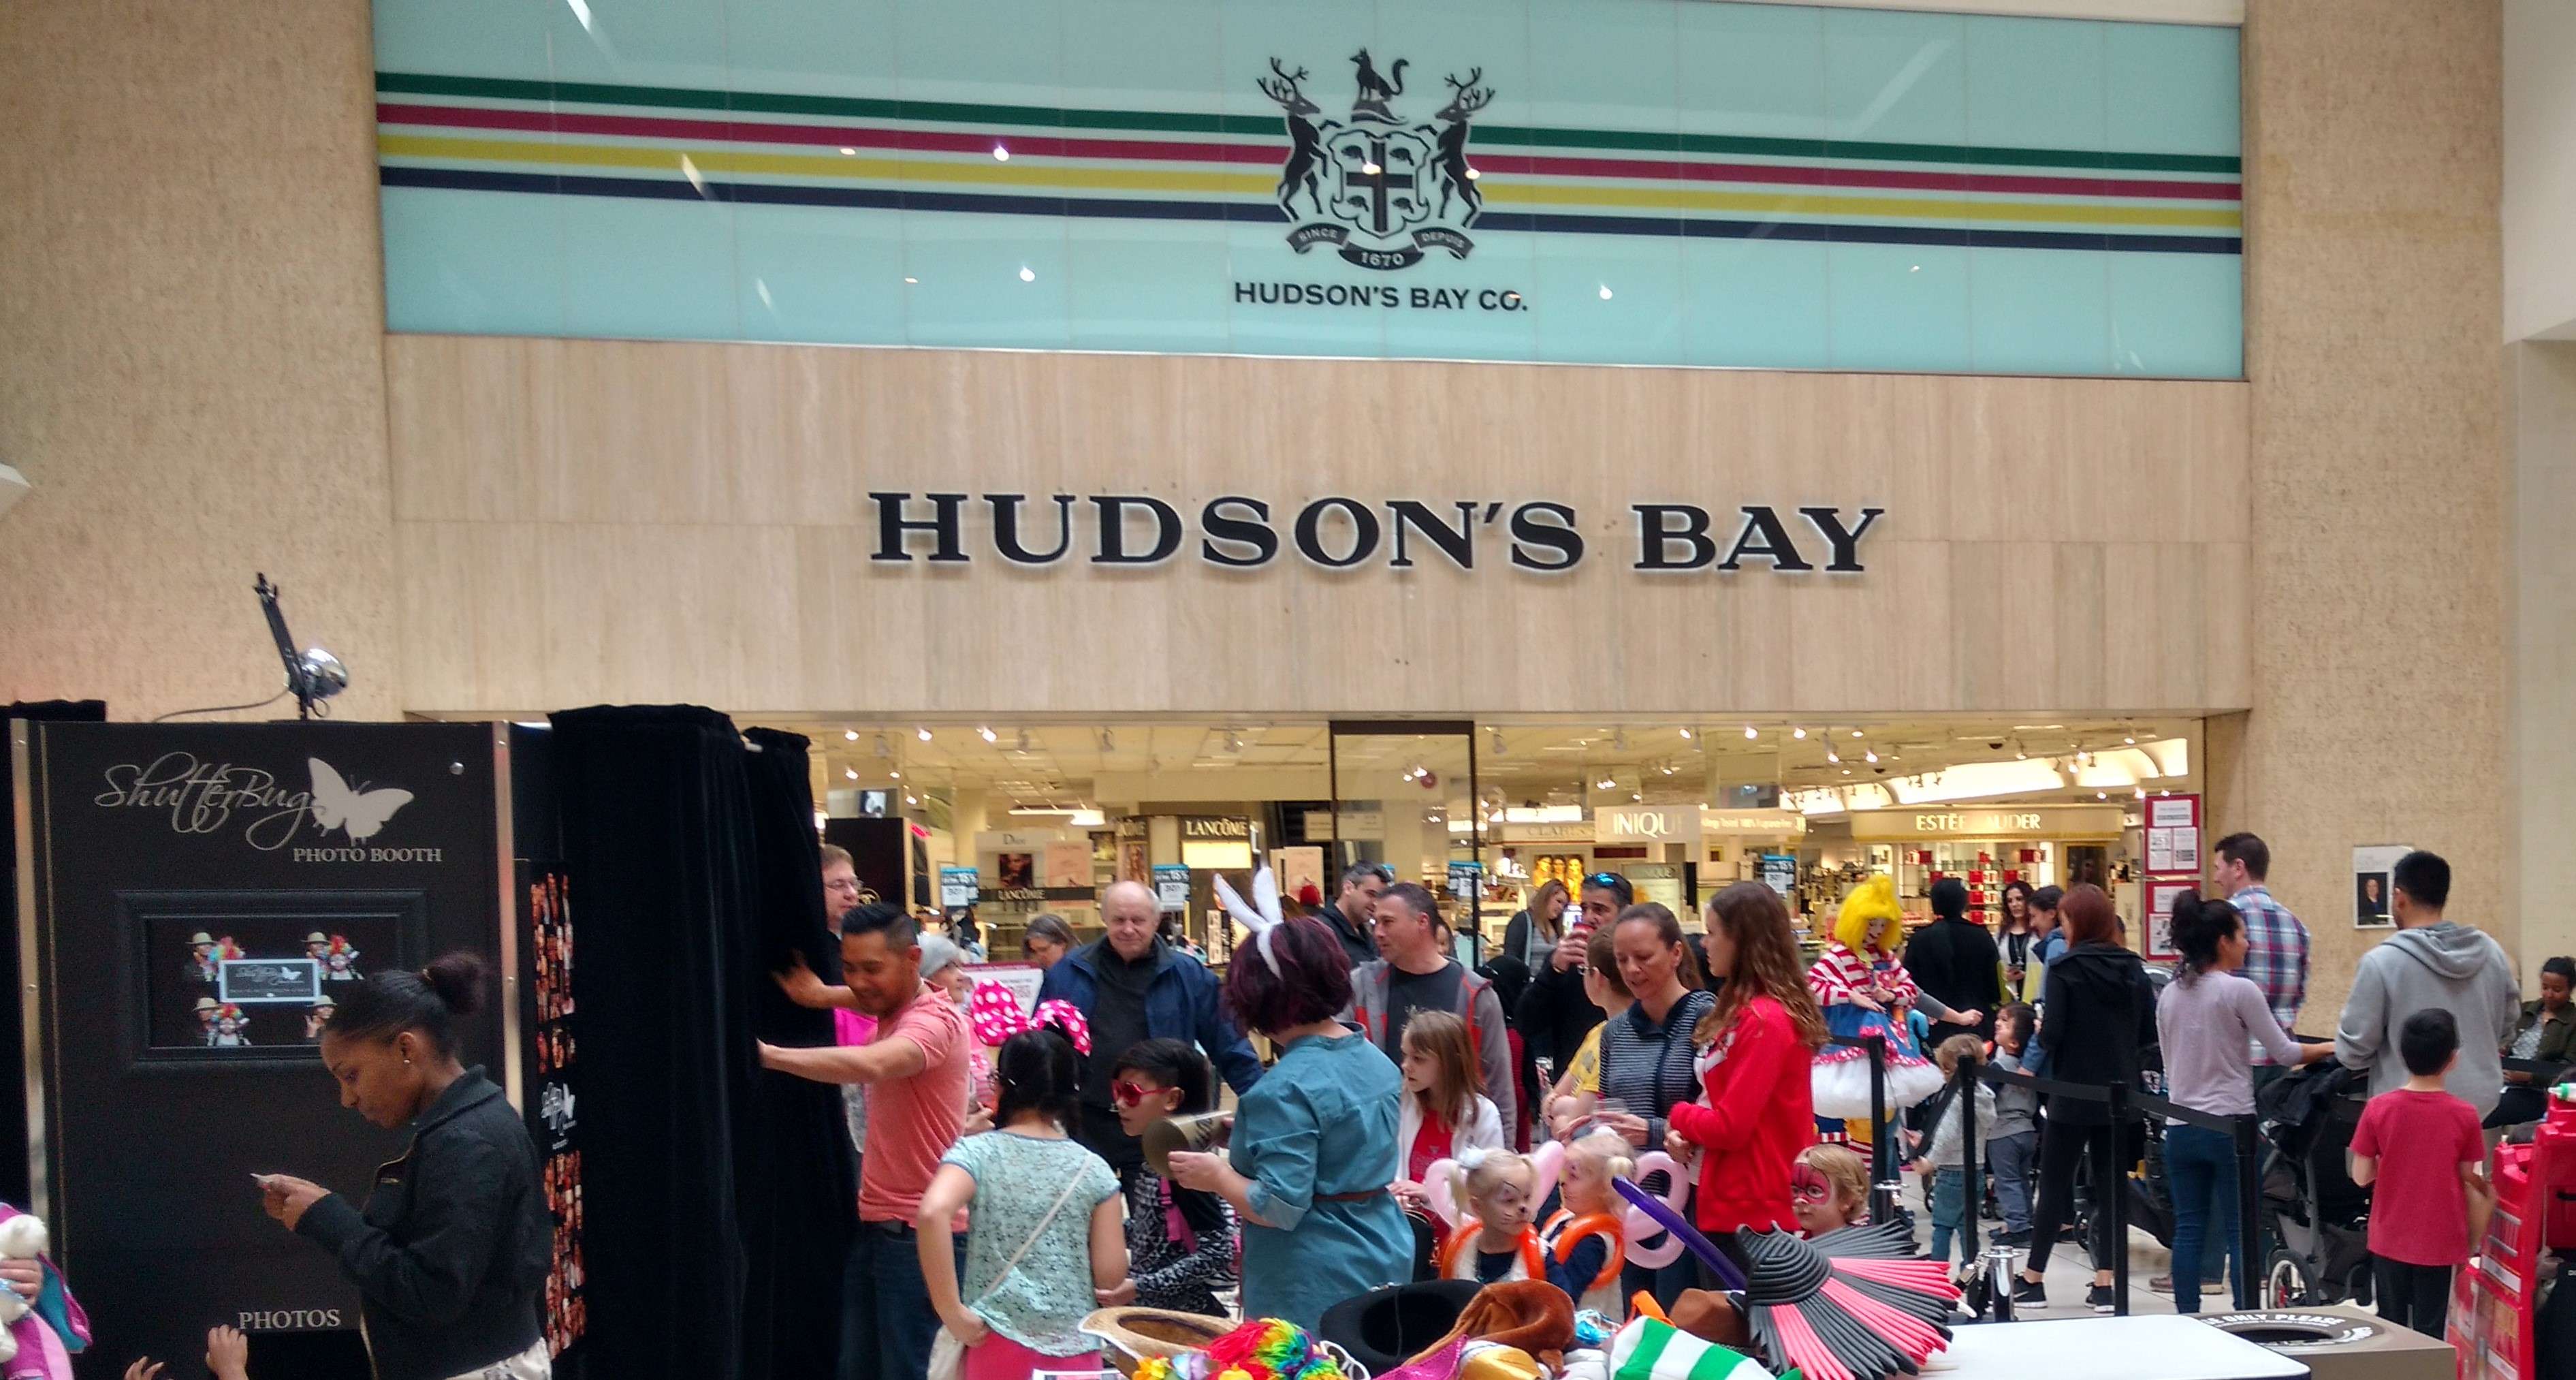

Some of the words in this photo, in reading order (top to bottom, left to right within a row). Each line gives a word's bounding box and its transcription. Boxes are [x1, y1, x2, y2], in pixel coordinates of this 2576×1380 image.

[1297, 229, 1337, 242] SINCE
[1420, 233, 1465, 248] DEPUIS
[1361, 251, 1405, 266] 1670
[1235, 282, 1399, 308] HUDSON'S
[1410, 287, 1469, 310] BAY
[1478, 289, 1528, 311] CO.
[868, 492, 1585, 571] HUDSON'S
[1632, 505, 1886, 573] BAY
[1185, 817, 1248, 836] LANCÔME
[293, 847, 366, 862] PHOTO
[370, 847, 443, 862] BOOTH
[238, 1308, 341, 1330] PHOTOS
[2222, 1313, 2268, 1323] ONLY
[2275, 1314, 2347, 1326] PLEASE
